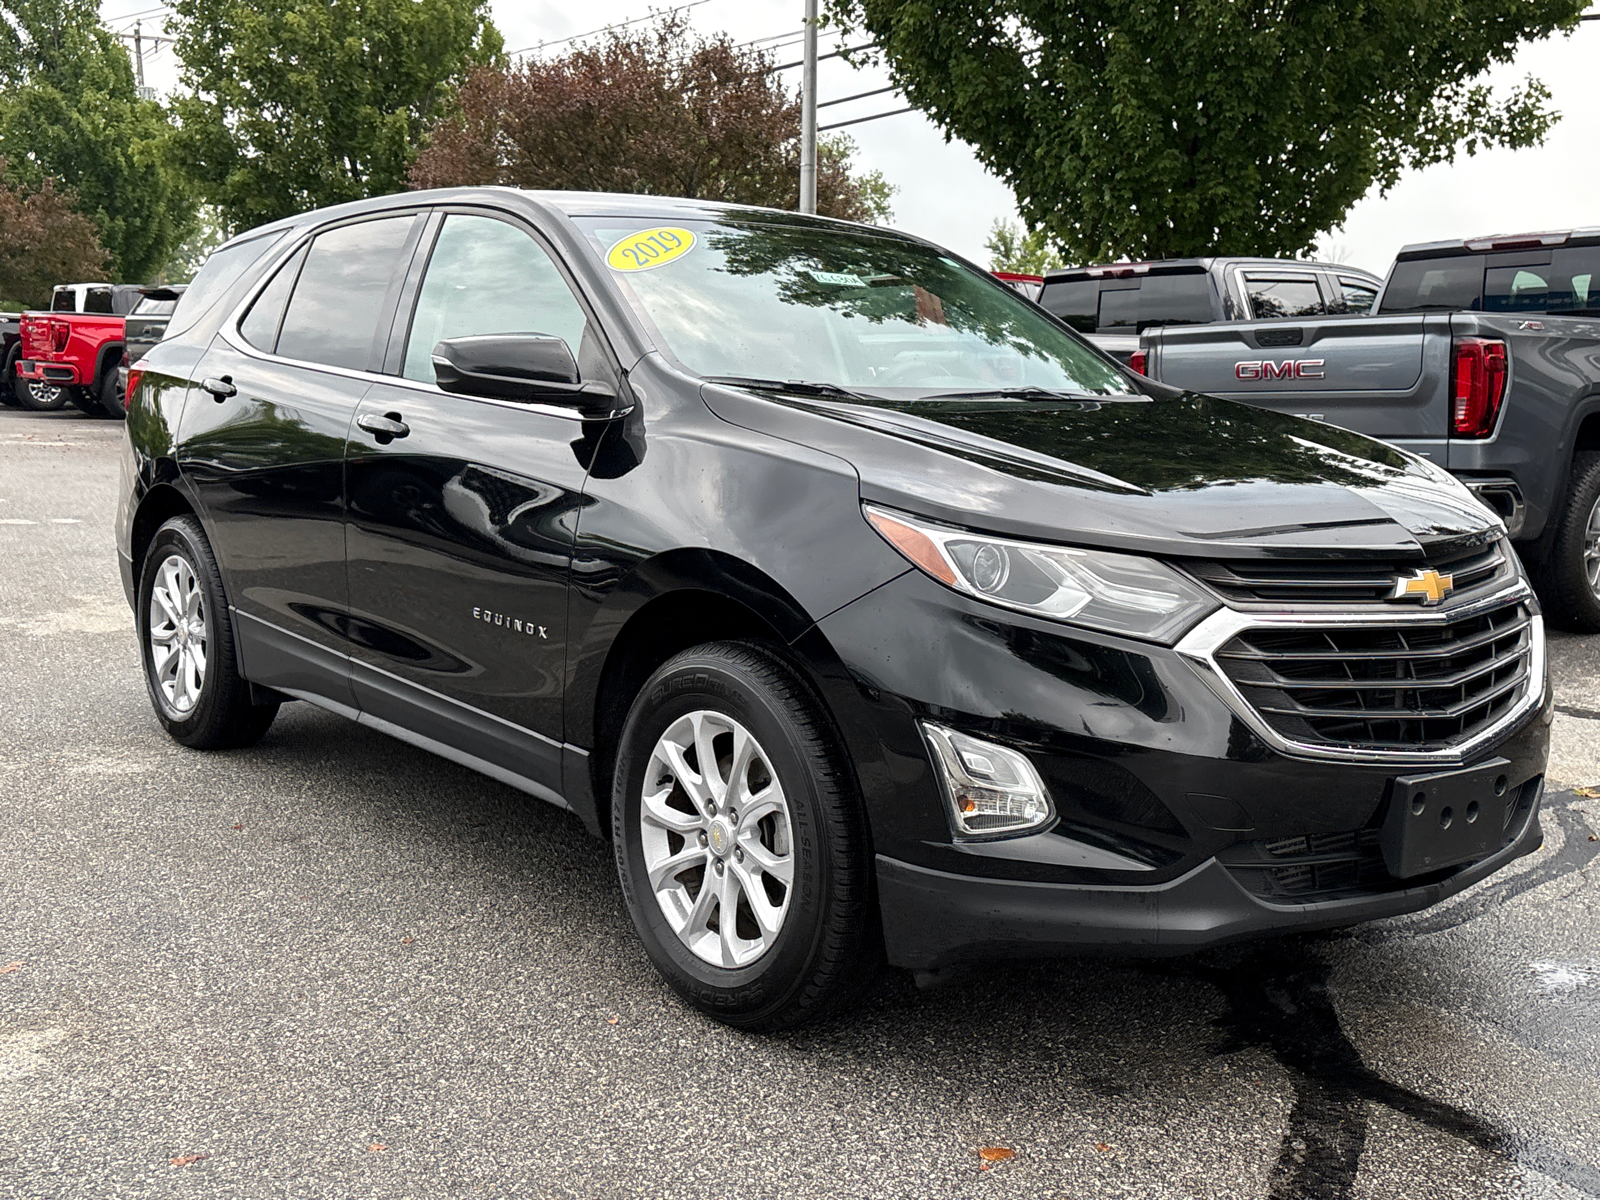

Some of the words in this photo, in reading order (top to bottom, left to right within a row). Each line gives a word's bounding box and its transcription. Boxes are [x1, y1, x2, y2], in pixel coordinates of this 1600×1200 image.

[622, 230, 682, 266] 2019
[1235, 359, 1325, 380] GMC
[473, 606, 548, 639] EQUINOX
